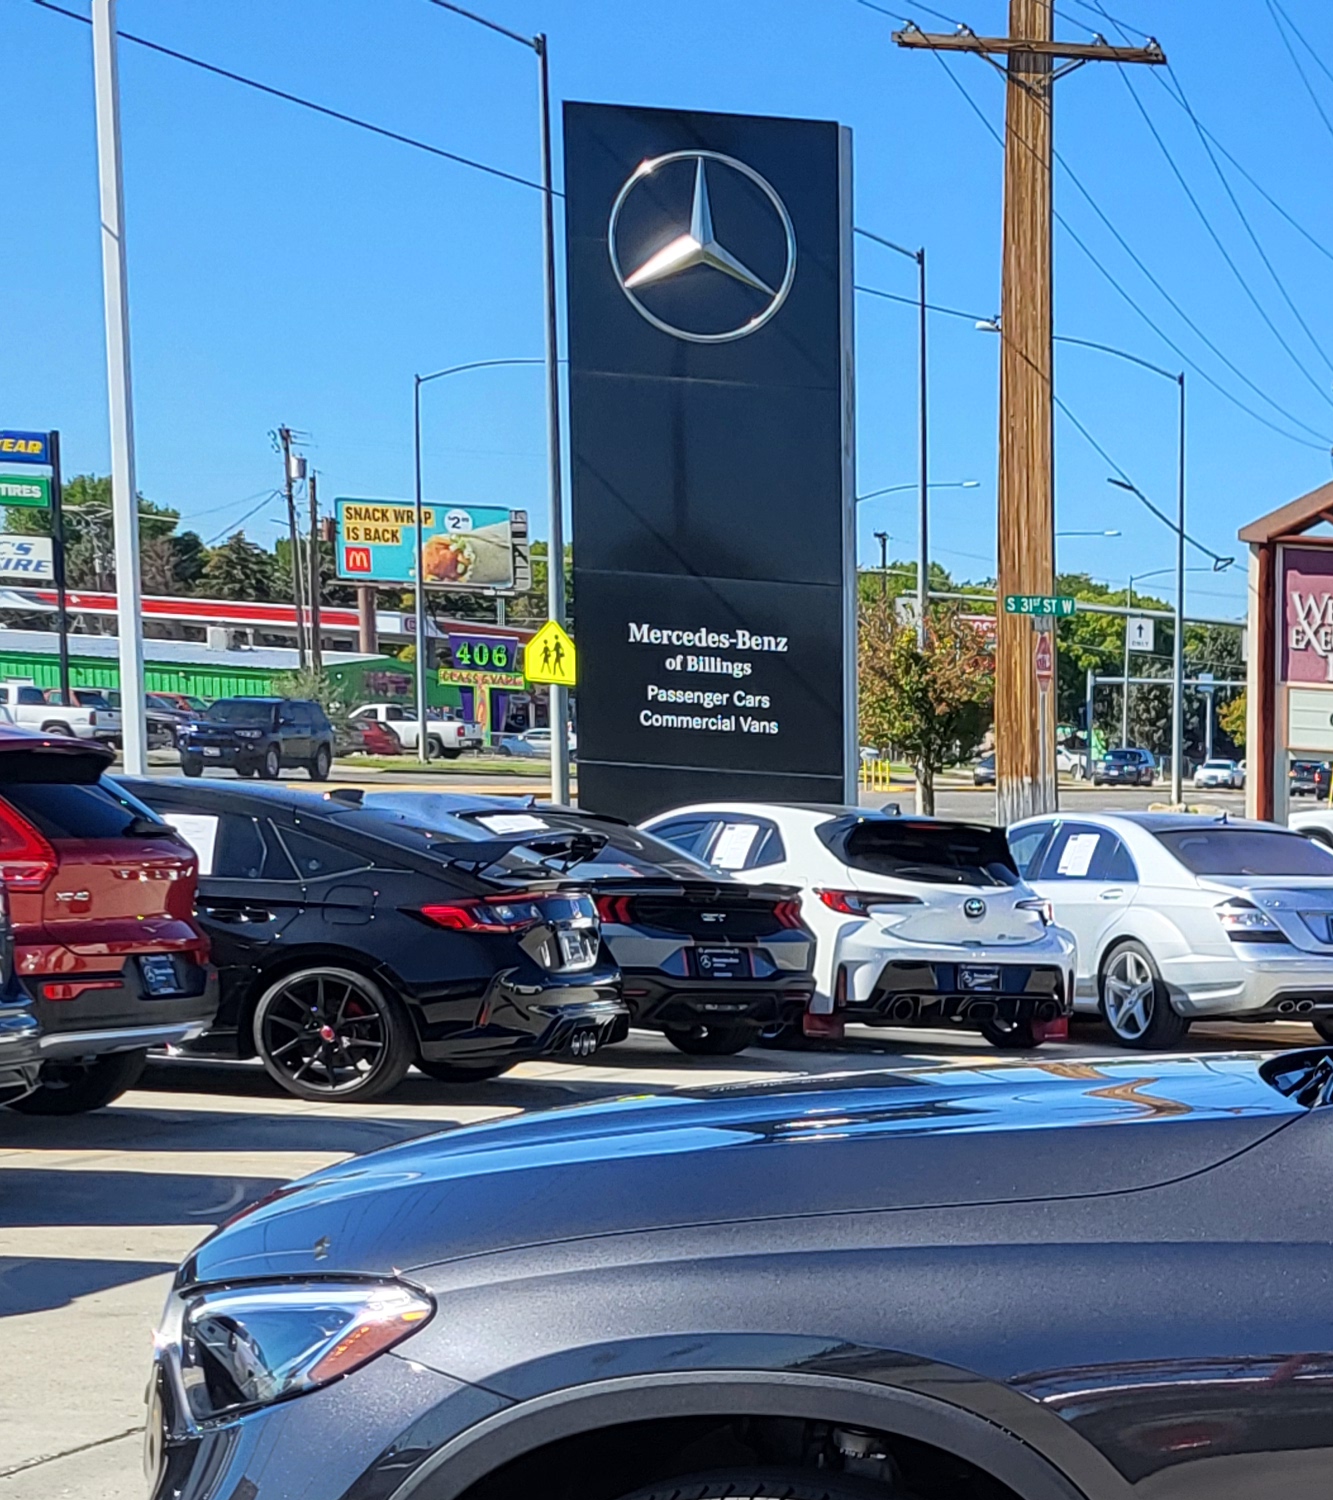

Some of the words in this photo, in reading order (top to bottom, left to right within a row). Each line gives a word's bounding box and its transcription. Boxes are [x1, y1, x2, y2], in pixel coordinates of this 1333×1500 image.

[345, 506, 390, 523] SNACK
[346, 526, 360, 541] IS
[364, 528, 400, 543] BACK
[0, 557, 52, 573] IRE
[1007, 597, 1016, 611] S
[1043, 598, 1057, 613] ST
[1061, 599, 1073, 614] W
[627, 622, 788, 652] Mercedes-Benz
[456, 641, 507, 667] 406
[665, 655, 683, 670] of
[686, 655, 752, 678] Billings
[647, 684, 730, 709] Passenger
[733, 690, 770, 708] Cars
[639, 709, 736, 731] Commercial
[739, 716, 779, 734] Vans
